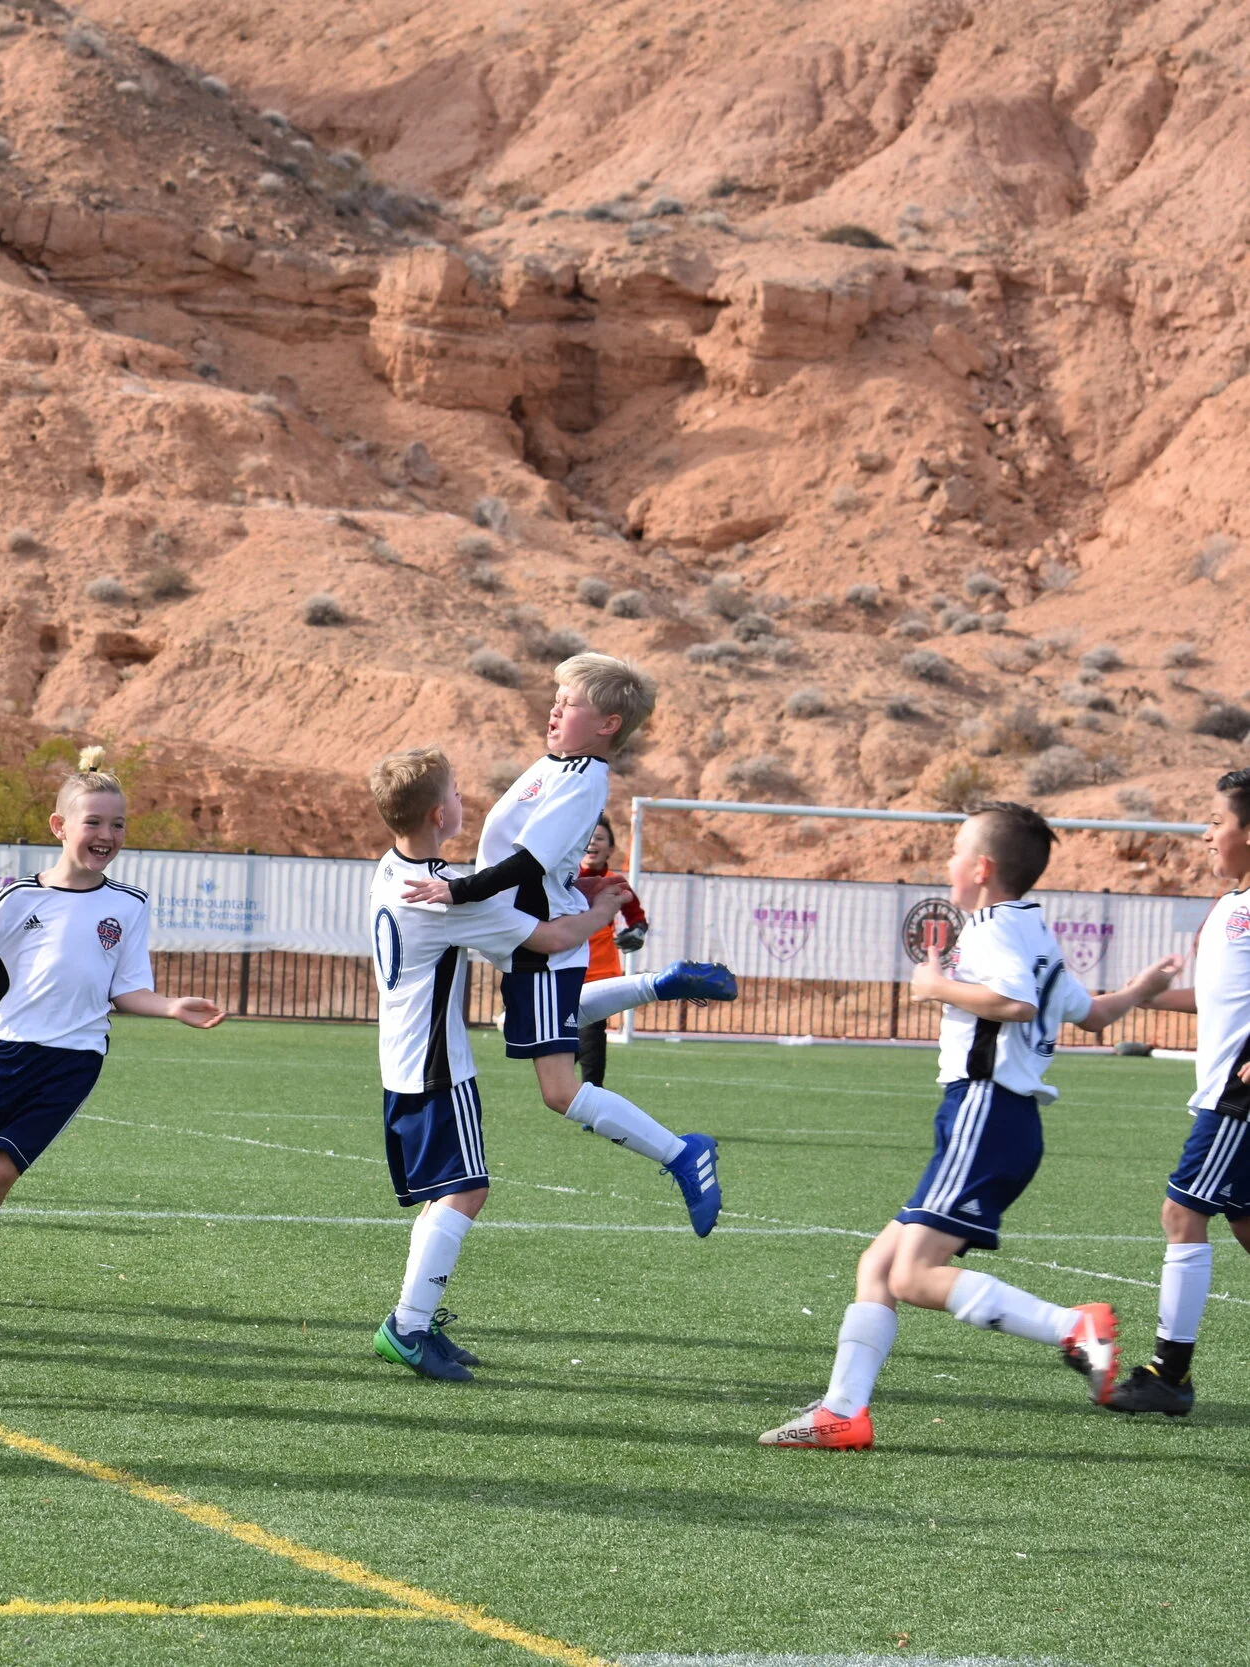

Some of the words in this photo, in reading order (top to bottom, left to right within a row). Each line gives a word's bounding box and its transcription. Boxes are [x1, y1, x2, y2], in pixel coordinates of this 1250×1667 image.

[158, 893, 258, 911] Intermountain
[754, 909, 817, 922] UTAH
[97, 925, 120, 942] USA
[210, 921, 254, 933] Hospital
[1054, 921, 1113, 935] UTAH
[777, 1421, 852, 1442] EVOSPEED
